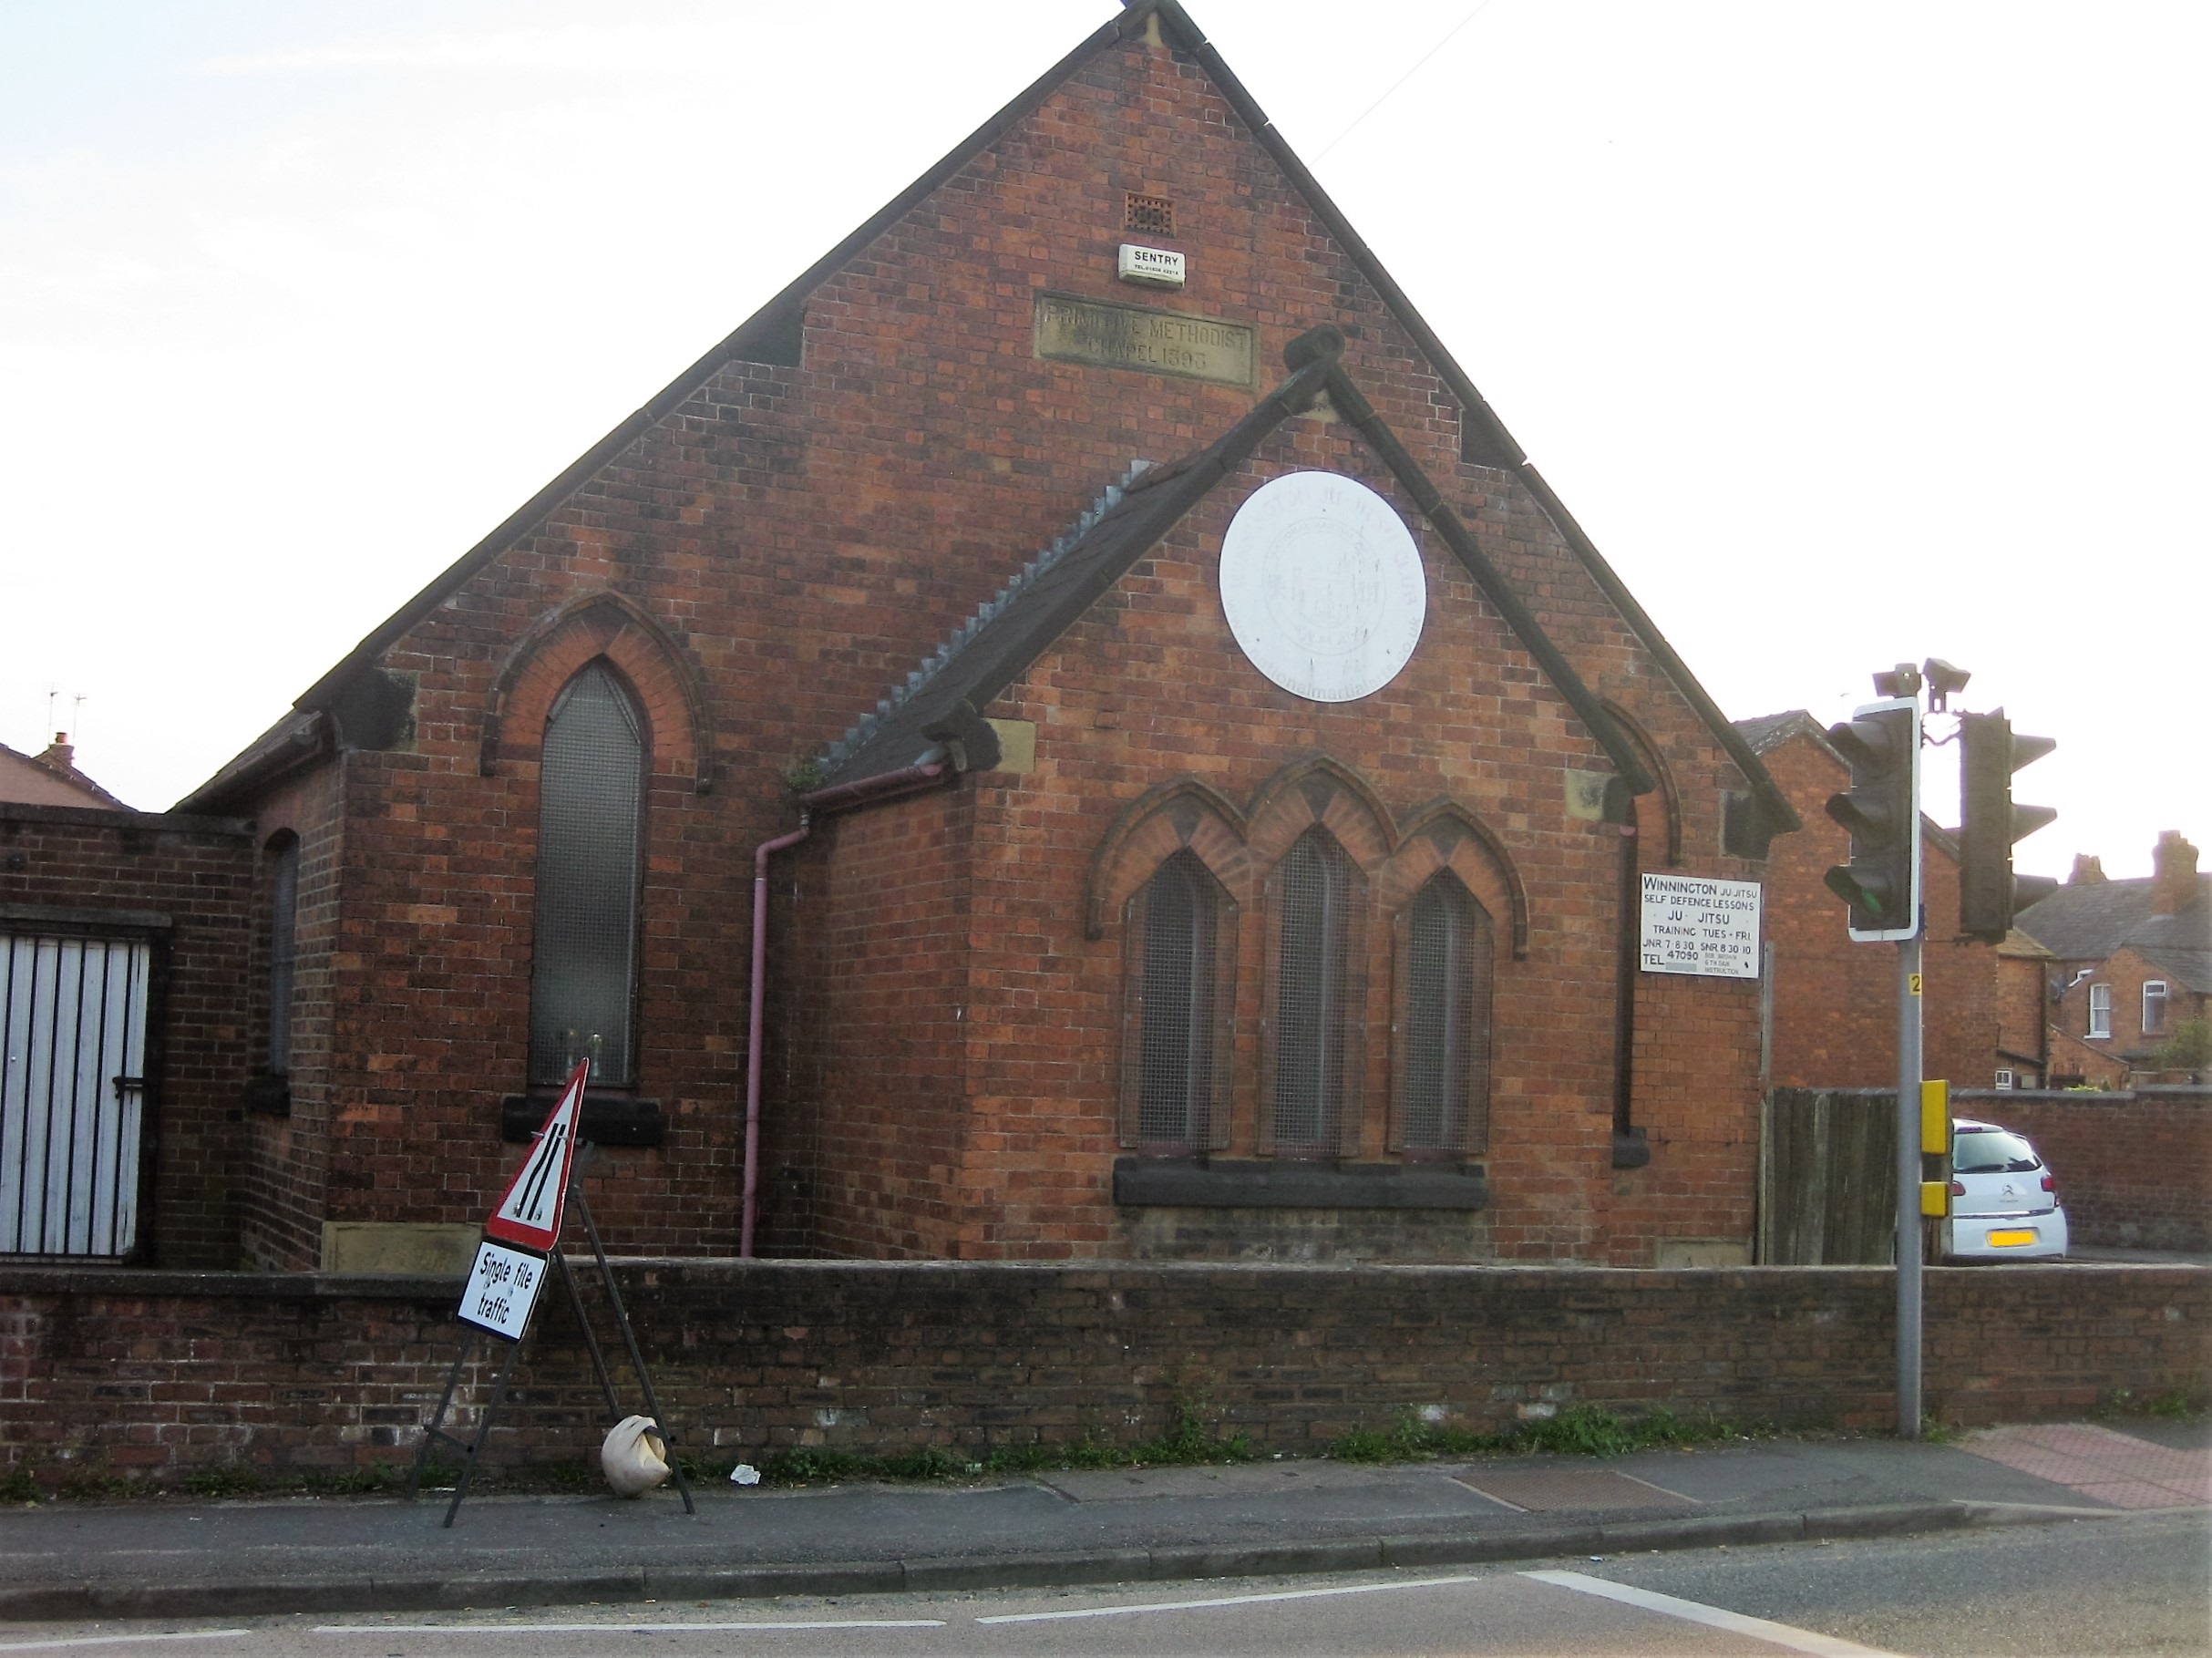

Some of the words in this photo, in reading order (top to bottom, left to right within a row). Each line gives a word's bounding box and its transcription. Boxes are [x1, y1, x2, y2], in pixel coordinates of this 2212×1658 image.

[1135, 251, 1178, 266] SENTRY
[1148, 319, 1247, 352] METHODIST
[1644, 894, 1667, 904] SELF
[1670, 896, 1712, 908] DEFENCE
[1713, 899, 1754, 911] LESSONS
[1734, 890, 1757, 899] JITSU
[1668, 910, 1682, 921] JU
[1698, 912, 1730, 925] JITSU
[1703, 929, 1726, 939] TUES
[1642, 953, 1665, 965] TEL
[1667, 950, 1699, 961] 47090
[1911, 974, 1920, 992] 2
[479, 1251, 511, 1284] Single
[513, 1262, 533, 1290] file
[477, 1292, 510, 1324] traffic
